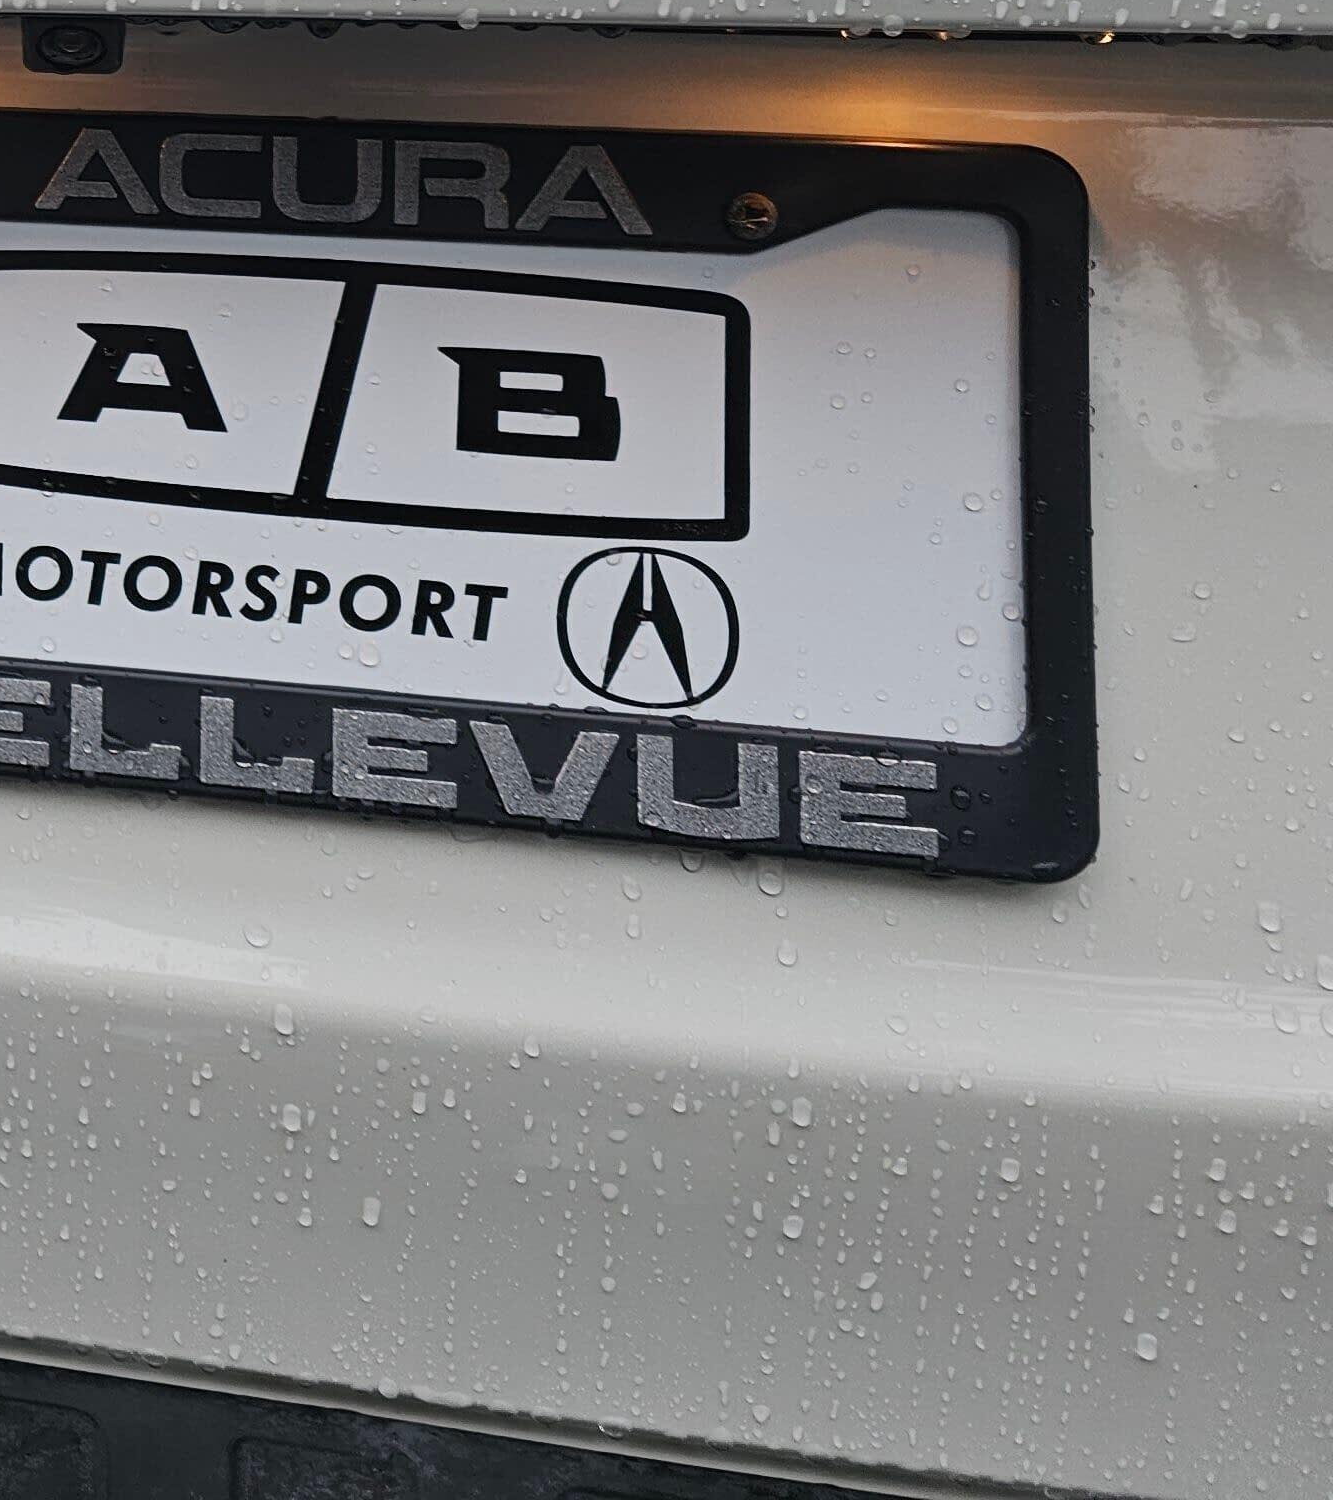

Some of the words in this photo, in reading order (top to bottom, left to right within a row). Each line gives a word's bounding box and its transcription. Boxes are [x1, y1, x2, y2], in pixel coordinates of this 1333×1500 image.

[35, 128, 654, 237] ACURA
[56, 322, 228, 433] A
[438, 346, 622, 463] B
